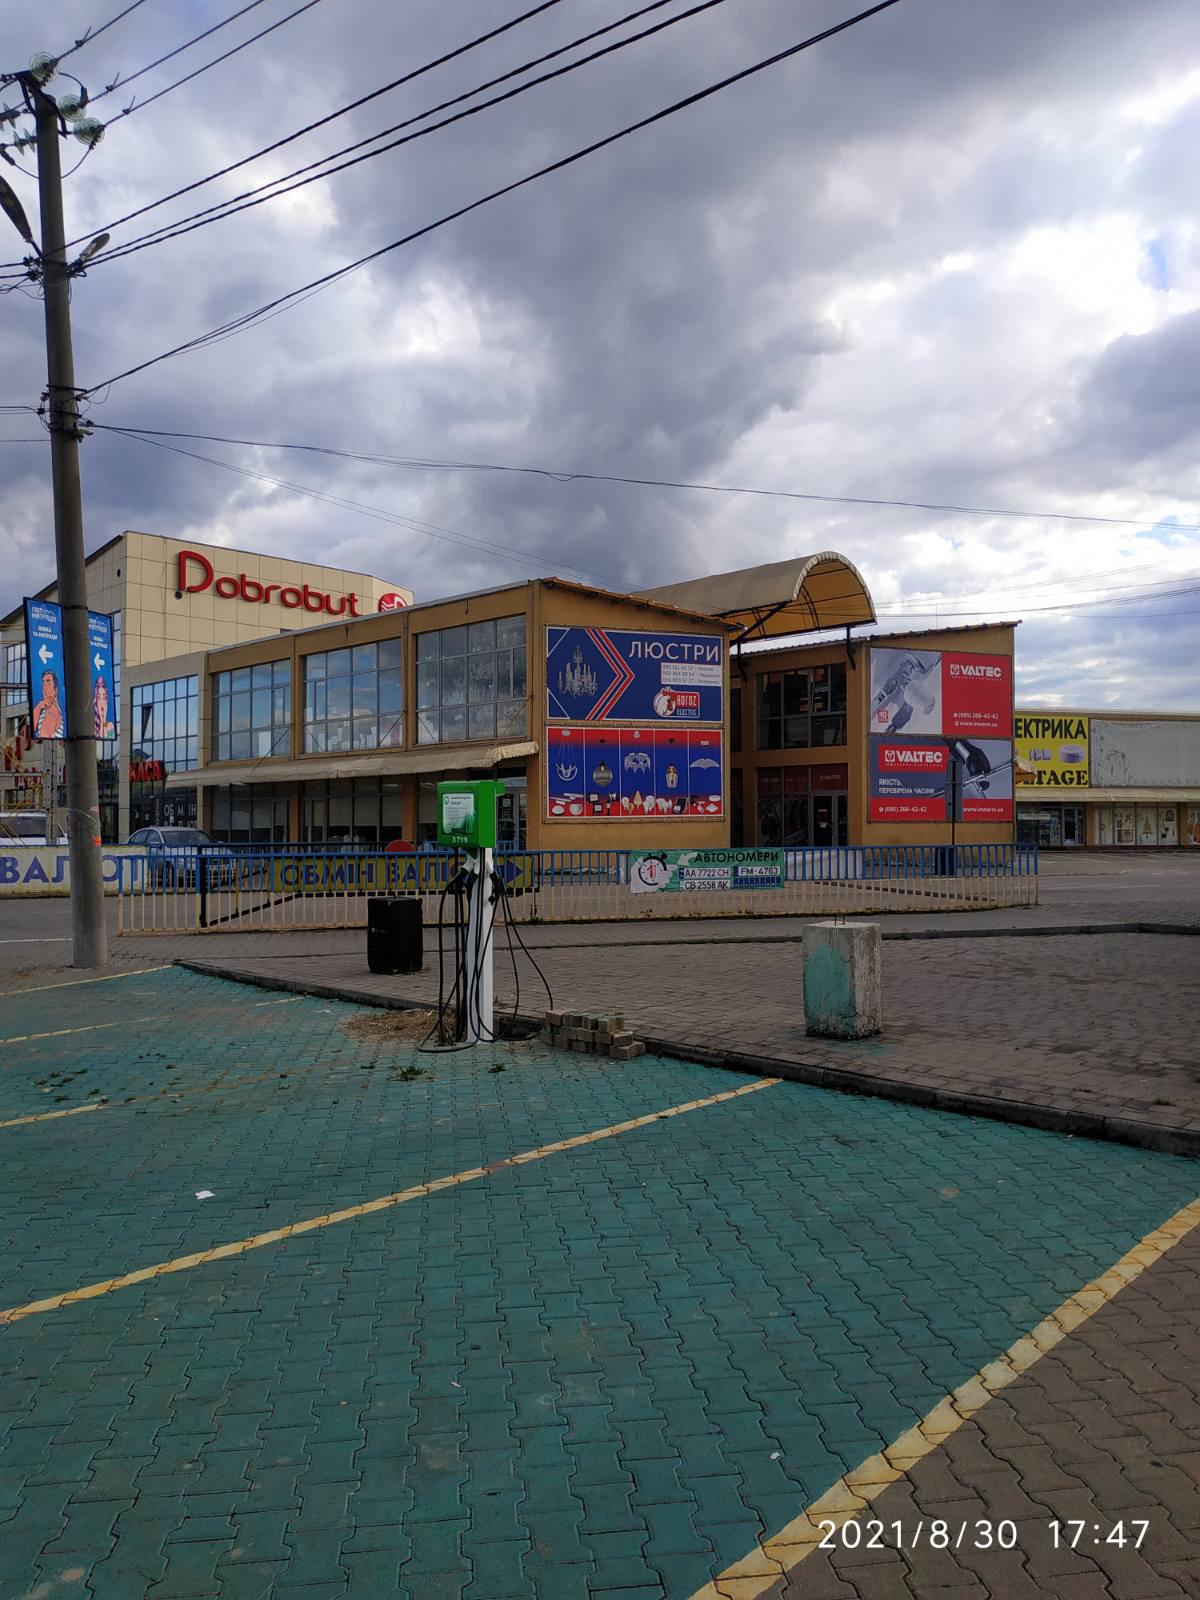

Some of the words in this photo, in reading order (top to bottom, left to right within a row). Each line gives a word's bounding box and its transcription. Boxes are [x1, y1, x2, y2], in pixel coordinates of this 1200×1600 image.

[178, 550, 363, 617] Dobrobut
[628, 641, 719, 662] ЛЮСТРИ
[960, 664, 1002, 677] VALTEC
[896, 750, 943, 763] VALTEC
[129, 761, 162, 782] КАСА
[694, 851, 779, 863] АВТОНОМЕРИ
[280, 863, 375, 886] ОБМІН
[697, 869, 716, 878] 7722
[697, 881, 716, 889] 2558
